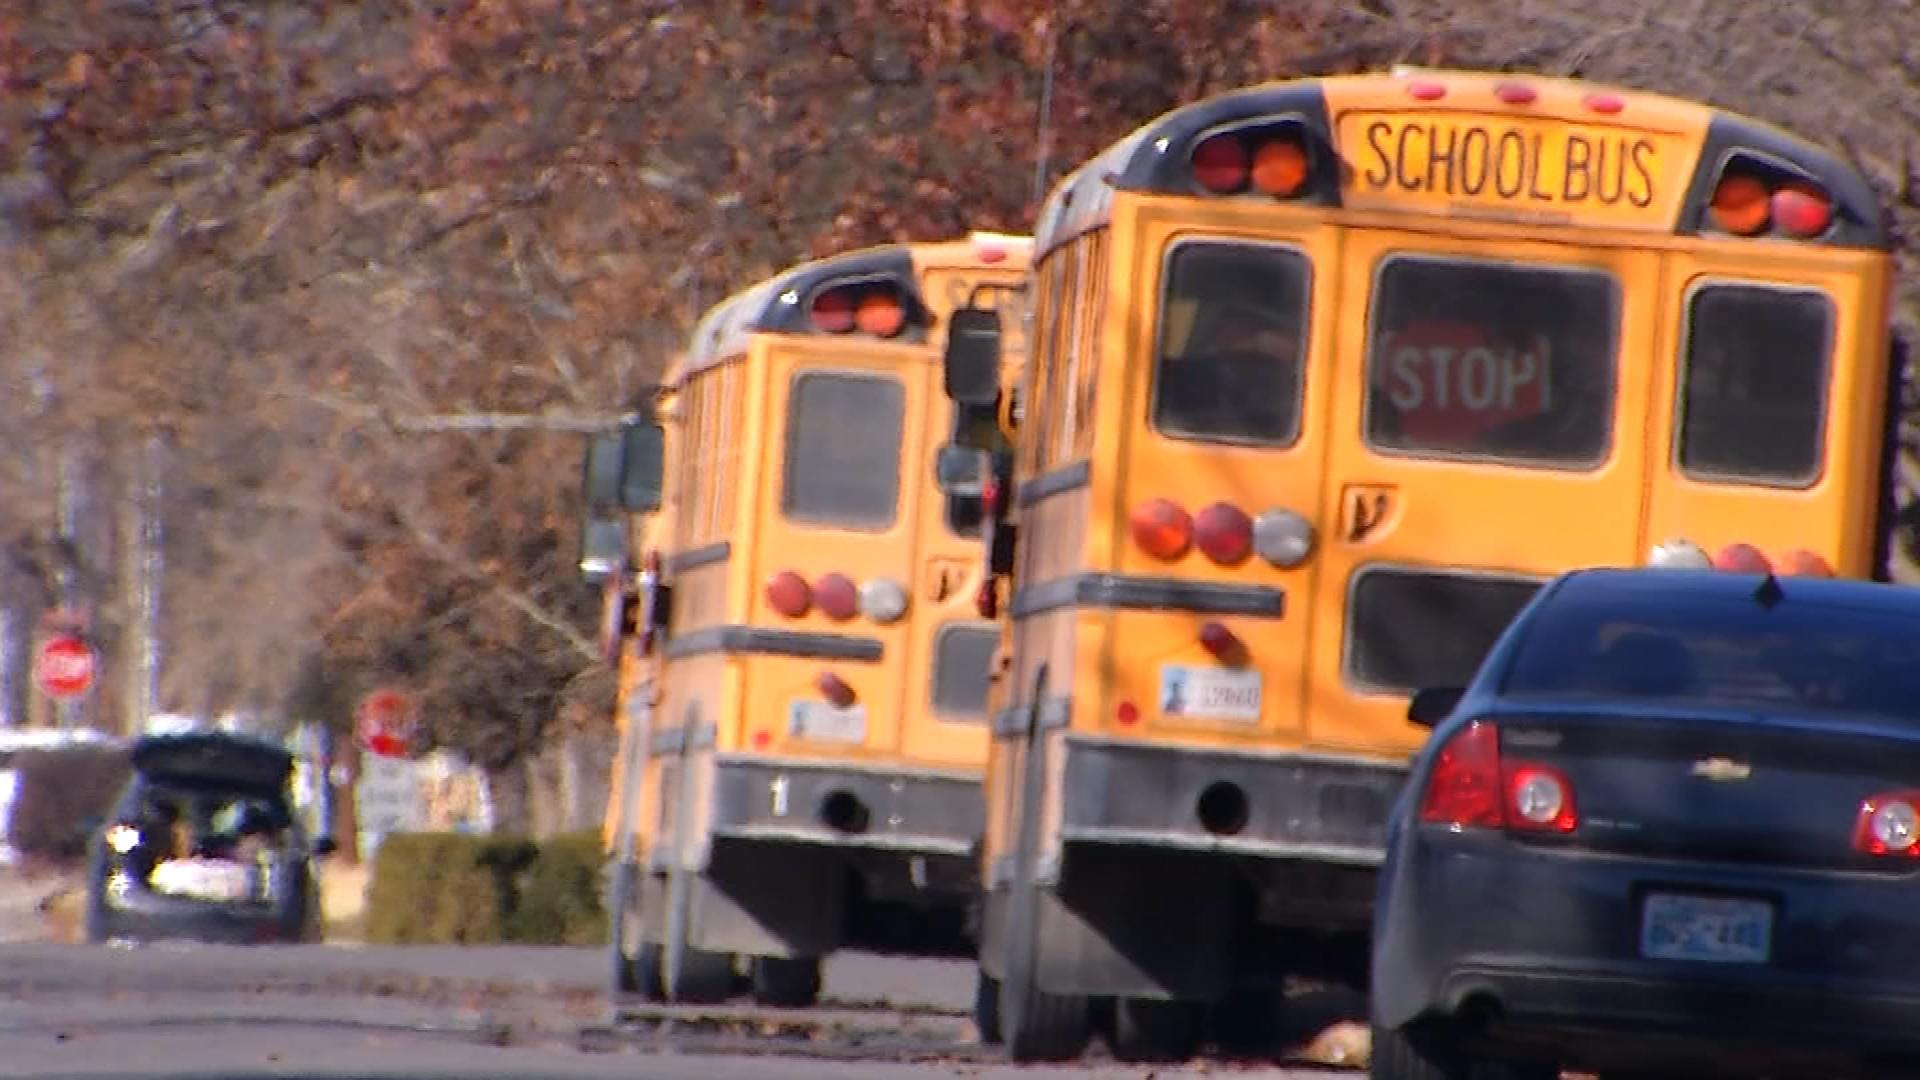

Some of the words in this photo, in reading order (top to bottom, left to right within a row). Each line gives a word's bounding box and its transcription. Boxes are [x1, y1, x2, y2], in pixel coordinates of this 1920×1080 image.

[1365, 120, 1553, 201] SCHOOL
[1562, 135, 1656, 208] BUS
[1390, 346, 1537, 410] STOP
